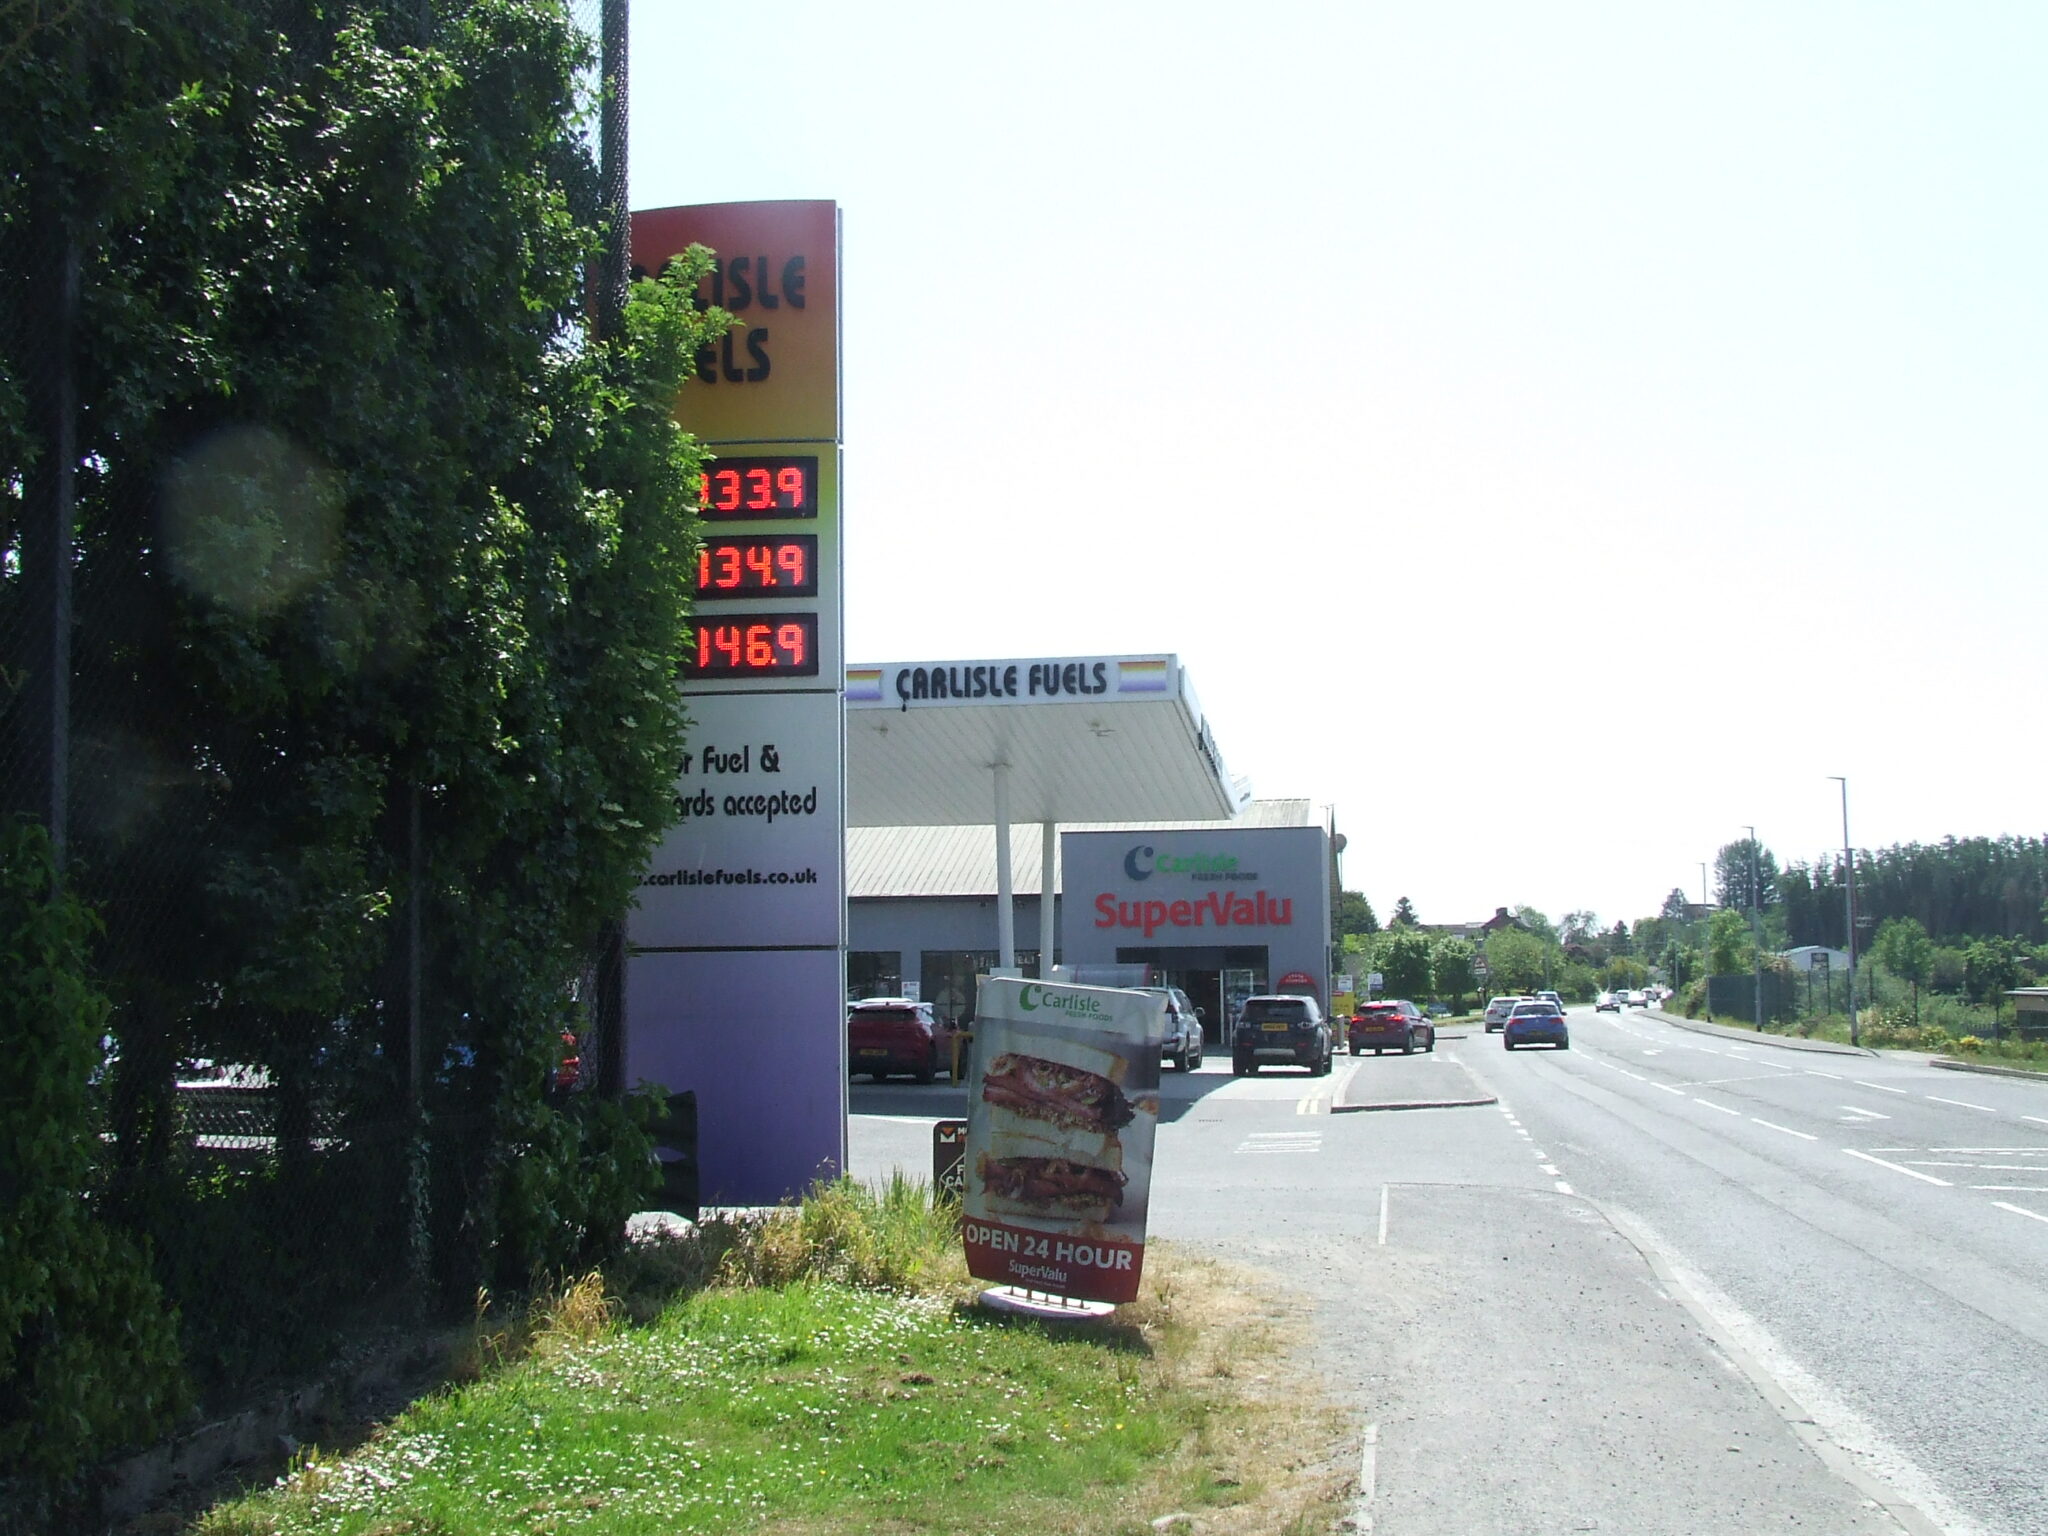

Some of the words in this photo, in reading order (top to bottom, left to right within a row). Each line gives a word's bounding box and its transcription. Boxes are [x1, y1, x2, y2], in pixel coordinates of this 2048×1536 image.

[697, 327, 771, 384] ELS
[698, 545, 804, 588] 134.9
[699, 624, 804, 668] 146.9
[896, 665, 1018, 701] CARLISLE
[1029, 662, 1108, 697] FUELS
[703, 745, 750, 774] Fuel
[760, 744, 781, 773] &
[673, 788, 715, 817] ards
[723, 786, 818, 824] accepted
[1094, 890, 1293, 938] SuperValu
[1042, 992, 1100, 1013] Carlisle
[966, 1223, 1019, 1253] OPEN
[1023, 1235, 1050, 1260] 24
[1055, 1241, 1134, 1271] HOUR
[1008, 1259, 1068, 1283] SuperValu
